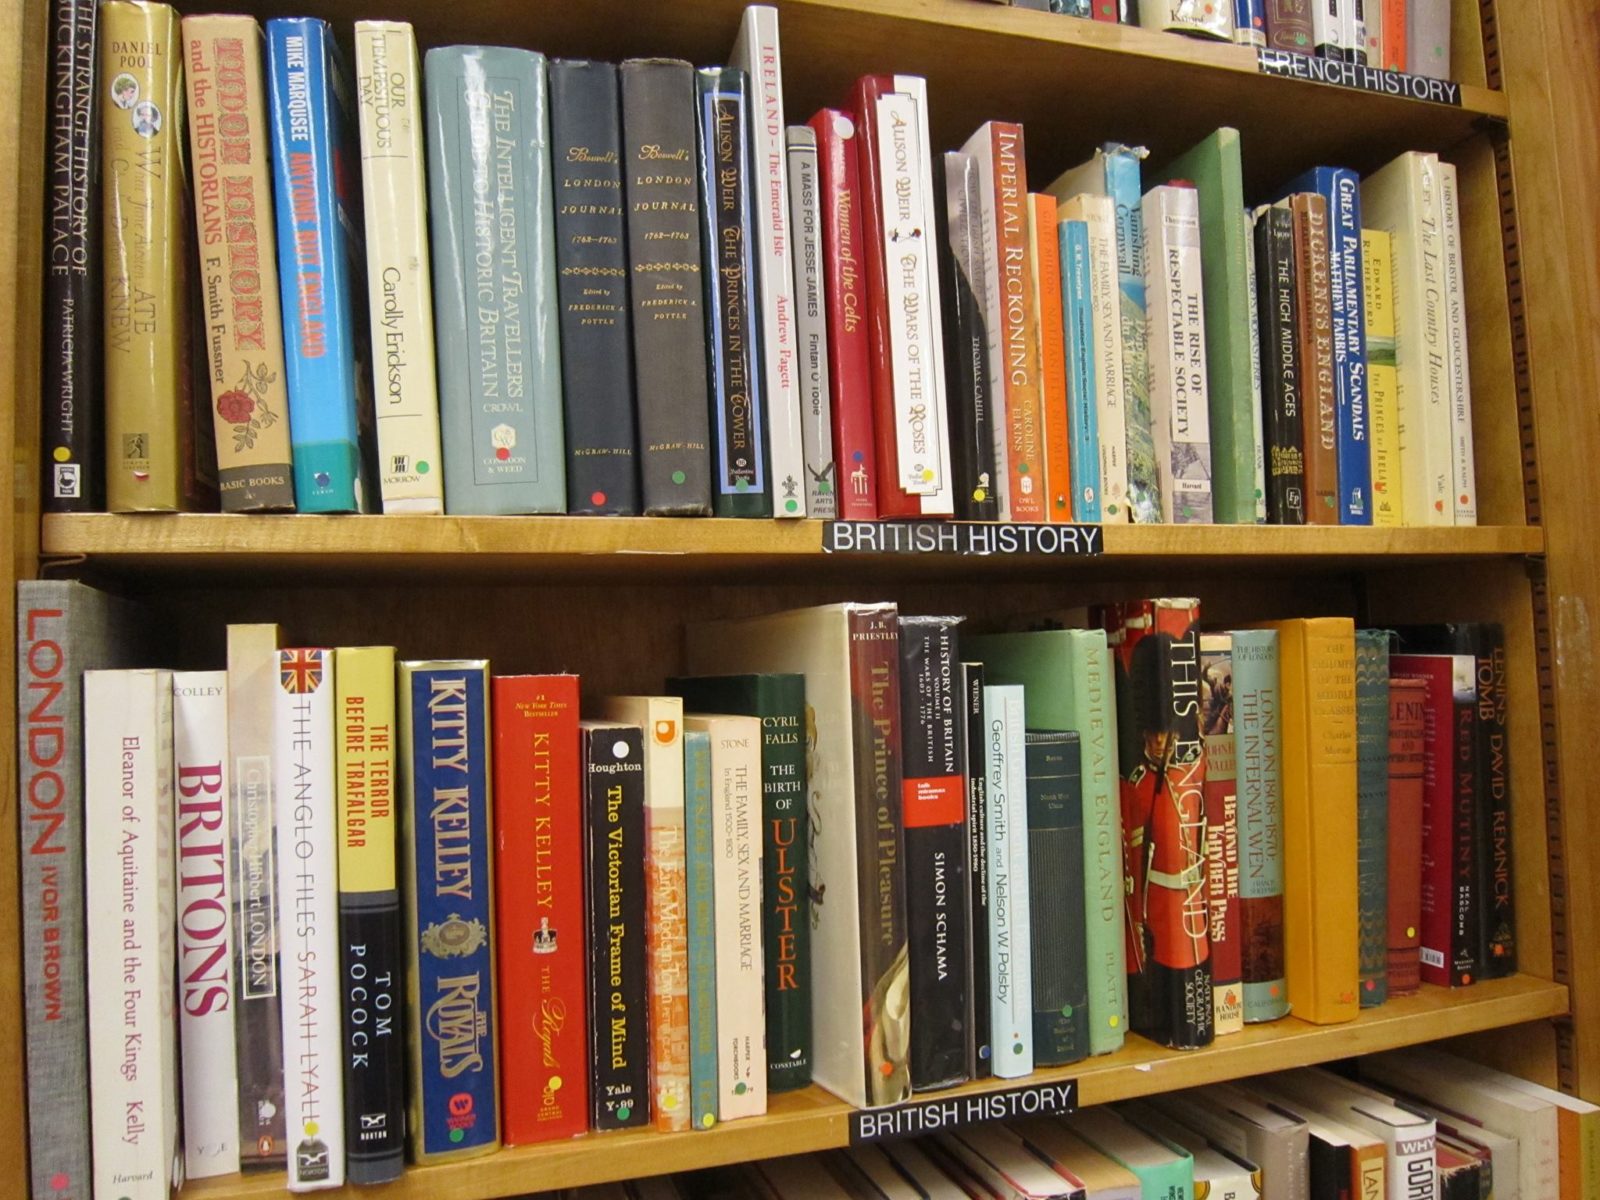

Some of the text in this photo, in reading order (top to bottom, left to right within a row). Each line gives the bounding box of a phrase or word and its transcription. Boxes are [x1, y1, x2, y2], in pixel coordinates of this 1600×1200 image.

[358, 75, 375, 107] DAY
[371, 34, 392, 150] TEMPESTUOUS
[390, 72, 406, 109] OUR
[1259, 50, 1457, 104] FRENCH HISTORY
[191, 40, 223, 246] and the HISTORIANS
[213, 37, 266, 351] TUDOR HISTORY
[286, 36, 327, 359] MIKE MARQUSEE ANYONE BUT ENGLAND
[561, 205, 625, 217] JOURNAL
[563, 178, 622, 190] LONDON
[633, 201, 697, 213] JOURNAL
[636, 175, 692, 186] LONDON
[801, 161, 818, 318] A MASS FOR JESSE JAMES
[838, 190, 862, 334] Women of the Celts
[999, 131, 1027, 387] IMPERIAL RECKONING
[1117, 203, 1132, 276] Cornwall
[1421, 217, 1437, 247] The
[1423, 249, 1438, 280] Last
[1329, 251, 1347, 362] MATTHEW PARRIS
[1340, 178, 1364, 441] GREAT PARLIAMENTARY SCANDALS
[1373, 257, 1383, 311] EDWARD
[1425, 286, 1440, 347] Country
[207, 257, 226, 384] F. Smith Fussner
[381, 266, 408, 406] Carolly Erickson
[1169, 248, 1189, 437] RESPECTABLE SOCIETY
[1186, 293, 1202, 397] THE RISE OF
[1278, 257, 1296, 417] THE HIGH MIDDLE AGES
[1310, 211, 1335, 450] DICKENS'S ENGLAND
[61, 298, 74, 434] PATRICIA WRIGHT
[1429, 351, 1444, 405] Houses
[1015, 407, 1023, 453] ELKINS
[1024, 400, 1035, 462] CAROLINE
[221, 475, 285, 491] BASIC BOOKS
[383, 474, 422, 485] MORROW
[832, 522, 1098, 554] BRITISH HISTORY
[173, 686, 223, 698] COLLEY
[933, 676, 941, 711] VOLUME
[939, 623, 955, 773] A HISTORY OF BRITAIN
[1242, 689, 1259, 730] THE
[1478, 657, 1495, 721] TOMB
[26, 608, 67, 856] LONDON
[720, 738, 749, 750] STONE
[763, 716, 799, 729] CYRIL
[765, 733, 798, 745] FALLS
[991, 719, 1006, 791] Geoffrey
[345, 695, 367, 849] BEFORE TRAFALGAR
[370, 723, 391, 819] THE TERROR
[427, 676, 473, 900] KITTY KELLEY
[588, 761, 643, 775] Houghton
[763, 781, 802, 794] BIRTH
[769, 764, 796, 776] THE
[1086, 648, 1114, 922] MEDIEVAL ENGLAND
[1245, 734, 1263, 831] INFERNAL
[1459, 708, 1473, 879] RED MUTINY
[532, 732, 553, 909] KITTY KELLEY
[775, 798, 793, 810] OF
[871, 660, 898, 946] The Prince of Pleasure
[994, 793, 1006, 842] Smith
[1490, 734, 1510, 909] DAVID REMNICK
[736, 763, 753, 972] THE FAMILY, SEX AND MARRIAGE
[996, 846, 1005, 869] and
[1223, 794, 1238, 899] BEYOND THE
[1249, 831, 1264, 879] WEN
[178, 759, 230, 1018] BRITONS
[293, 699, 320, 1127] THE ANGLO FILES SARAH LYALL
[772, 818, 799, 991] ULSTER
[996, 874, 1007, 928] Nelson
[1208, 824, 1228, 942] KHYBER PASS
[117, 735, 147, 1146] Eleanor of Aquitaine and the Four Kings Kelly
[607, 784, 627, 1071] The Victorian Frame of Mind
[934, 852, 949, 982] SIMON SCHAMA
[350, 943, 370, 1070] POCOCK
[374, 971, 392, 1037] TOM
[540, 965, 551, 993] THE
[998, 951, 1010, 1005] Polsby
[1184, 981, 1196, 1025] SOCIETY
[426, 970, 485, 1080] ROYALS
[605, 1083, 632, 1096] Yale
[770, 1058, 808, 1071] CONSTABLE
[360, 1130, 388, 1141] NORTON
[859, 1085, 1072, 1139] BRITISH HISTORY
[112, 1171, 153, 1185] Harvard
[1400, 1137, 1436, 1156] WHY
